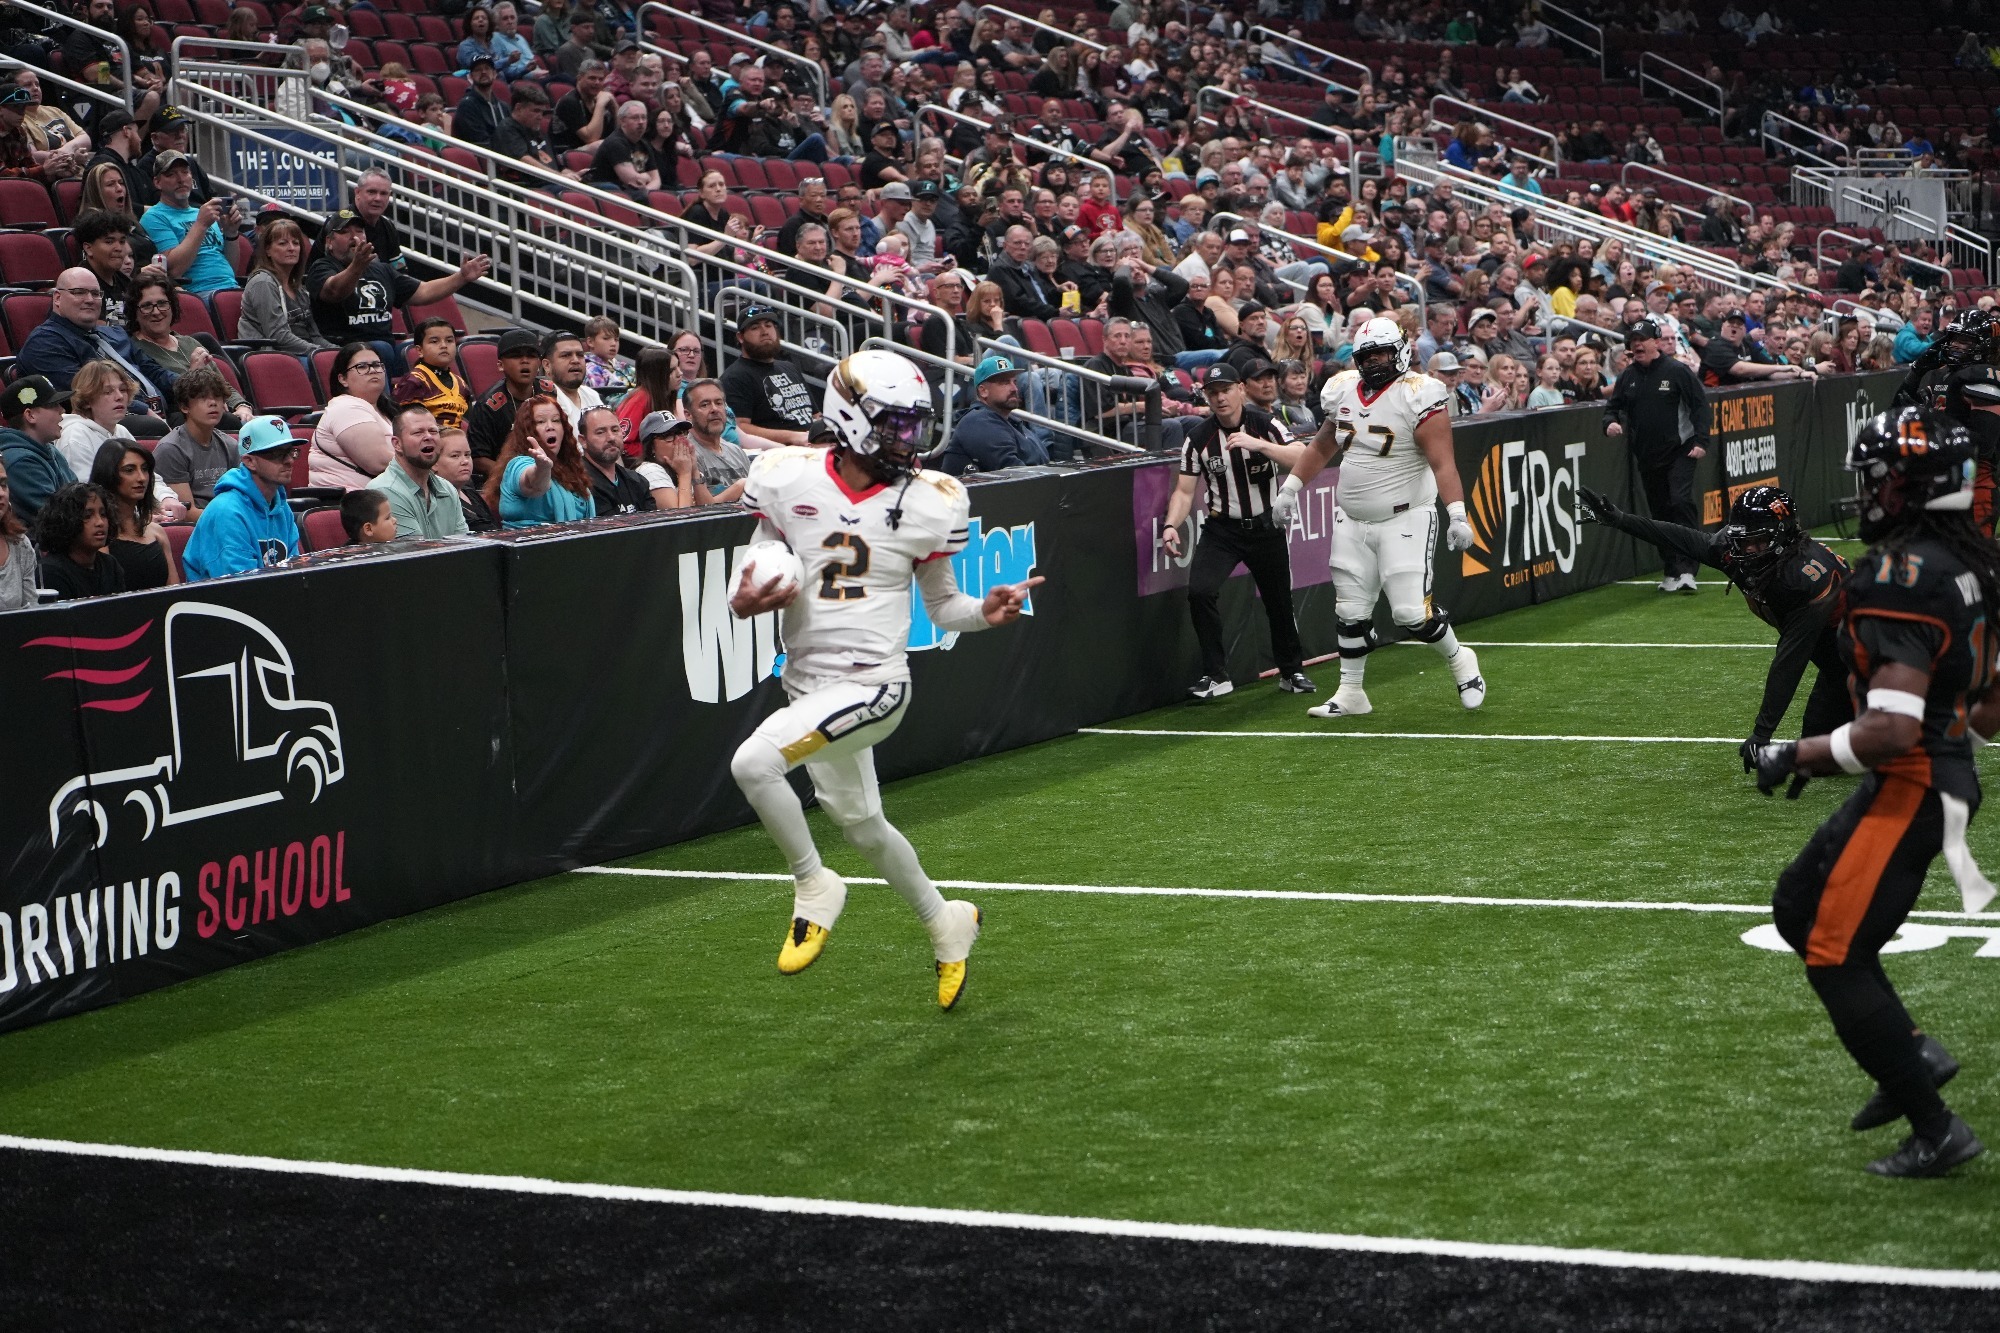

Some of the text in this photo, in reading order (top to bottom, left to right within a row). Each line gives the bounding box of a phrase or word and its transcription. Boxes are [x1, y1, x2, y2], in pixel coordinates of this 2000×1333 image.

[236, 151, 268, 170] THE
[1721, 399, 1746, 433] GAME
[1745, 394, 1775, 428] TICKETS
[1898, 420, 1928, 457] 15
[1251, 461, 1269, 474] 97
[1502, 440, 1586, 574] FIRST
[818, 531, 871, 600] 2
[1503, 560, 1556, 588] CREDIT UNION
[1801, 558, 1828, 581] 91
[855, 682, 902, 721] VEGA
[0, 830, 352, 994] DRIVING SCHOOL
